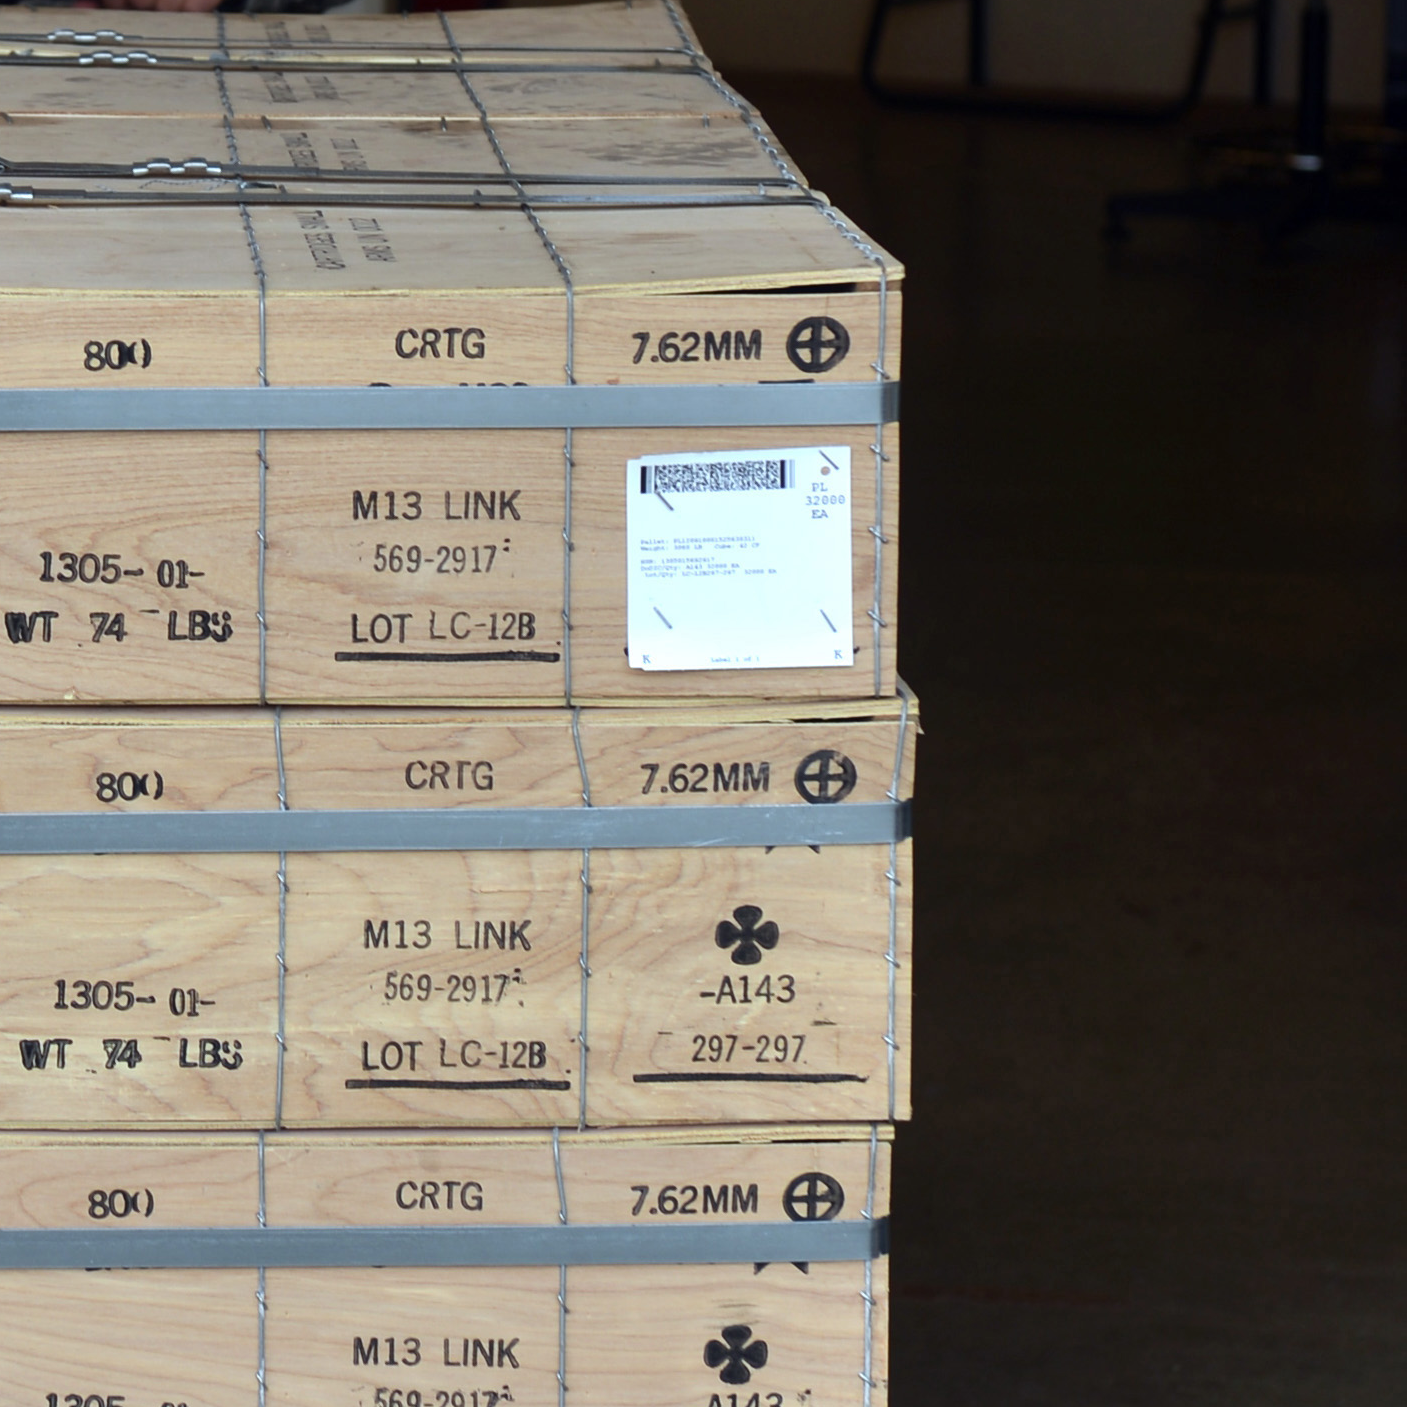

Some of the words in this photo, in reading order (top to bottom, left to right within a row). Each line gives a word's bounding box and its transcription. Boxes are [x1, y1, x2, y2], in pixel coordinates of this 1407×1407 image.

[84, 339, 151, 371] 800
[395, 328, 485, 359] CRTG
[632, 329, 761, 364] 7.62MM
[806, 495, 845, 505] 32000
[812, 483, 828, 492] PL
[353, 490, 421, 520] M13
[445, 490, 521, 520] LINK
[812, 510, 828, 519] EA
[5, 611, 59, 644] WT
[89, 612, 128, 643] 74
[352, 614, 412, 643] LOT
[430, 611, 535, 640] LC-12B
[643, 655, 651, 664] K
[834, 650, 843, 659] K
[96, 771, 163, 803] 800
[405, 761, 493, 790] CRTG
[641, 762, 769, 794] 7.62MM
[364, 919, 431, 949] M13
[455, 920, 531, 951] LINK
[19, 1039, 73, 1070] WT
[103, 1039, 142, 1069] 74
[362, 1041, 423, 1071] LOT
[440, 1038, 546, 1069] LC-12B
[692, 1035, 805, 1063] 297-297
[88, 1189, 154, 1219] 800
[396, 1181, 482, 1210] CRTG
[631, 1184, 758, 1216] 7.62MM
[353, 1337, 421, 1366] M13
[444, 1338, 519, 1369] LINK
